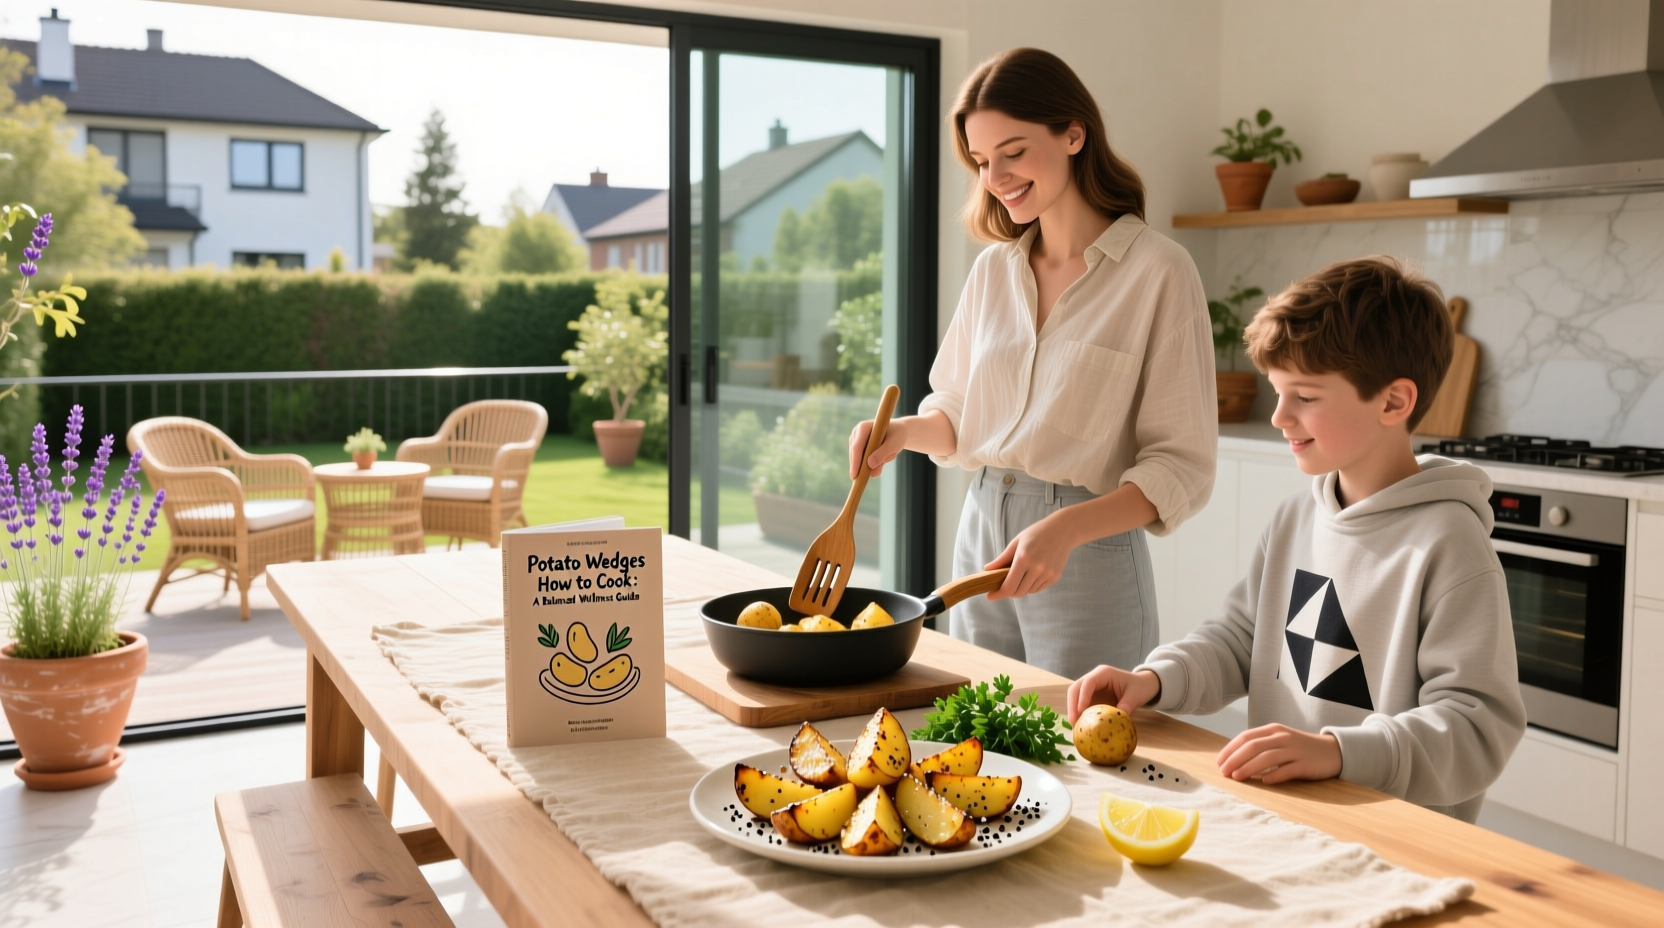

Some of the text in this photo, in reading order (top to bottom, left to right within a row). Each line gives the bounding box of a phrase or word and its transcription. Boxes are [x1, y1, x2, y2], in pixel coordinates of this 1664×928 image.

[528, 551, 645, 573] Potato Wedges
[538, 572, 638, 592] How to Cook:
[532, 597, 540, 606] A
